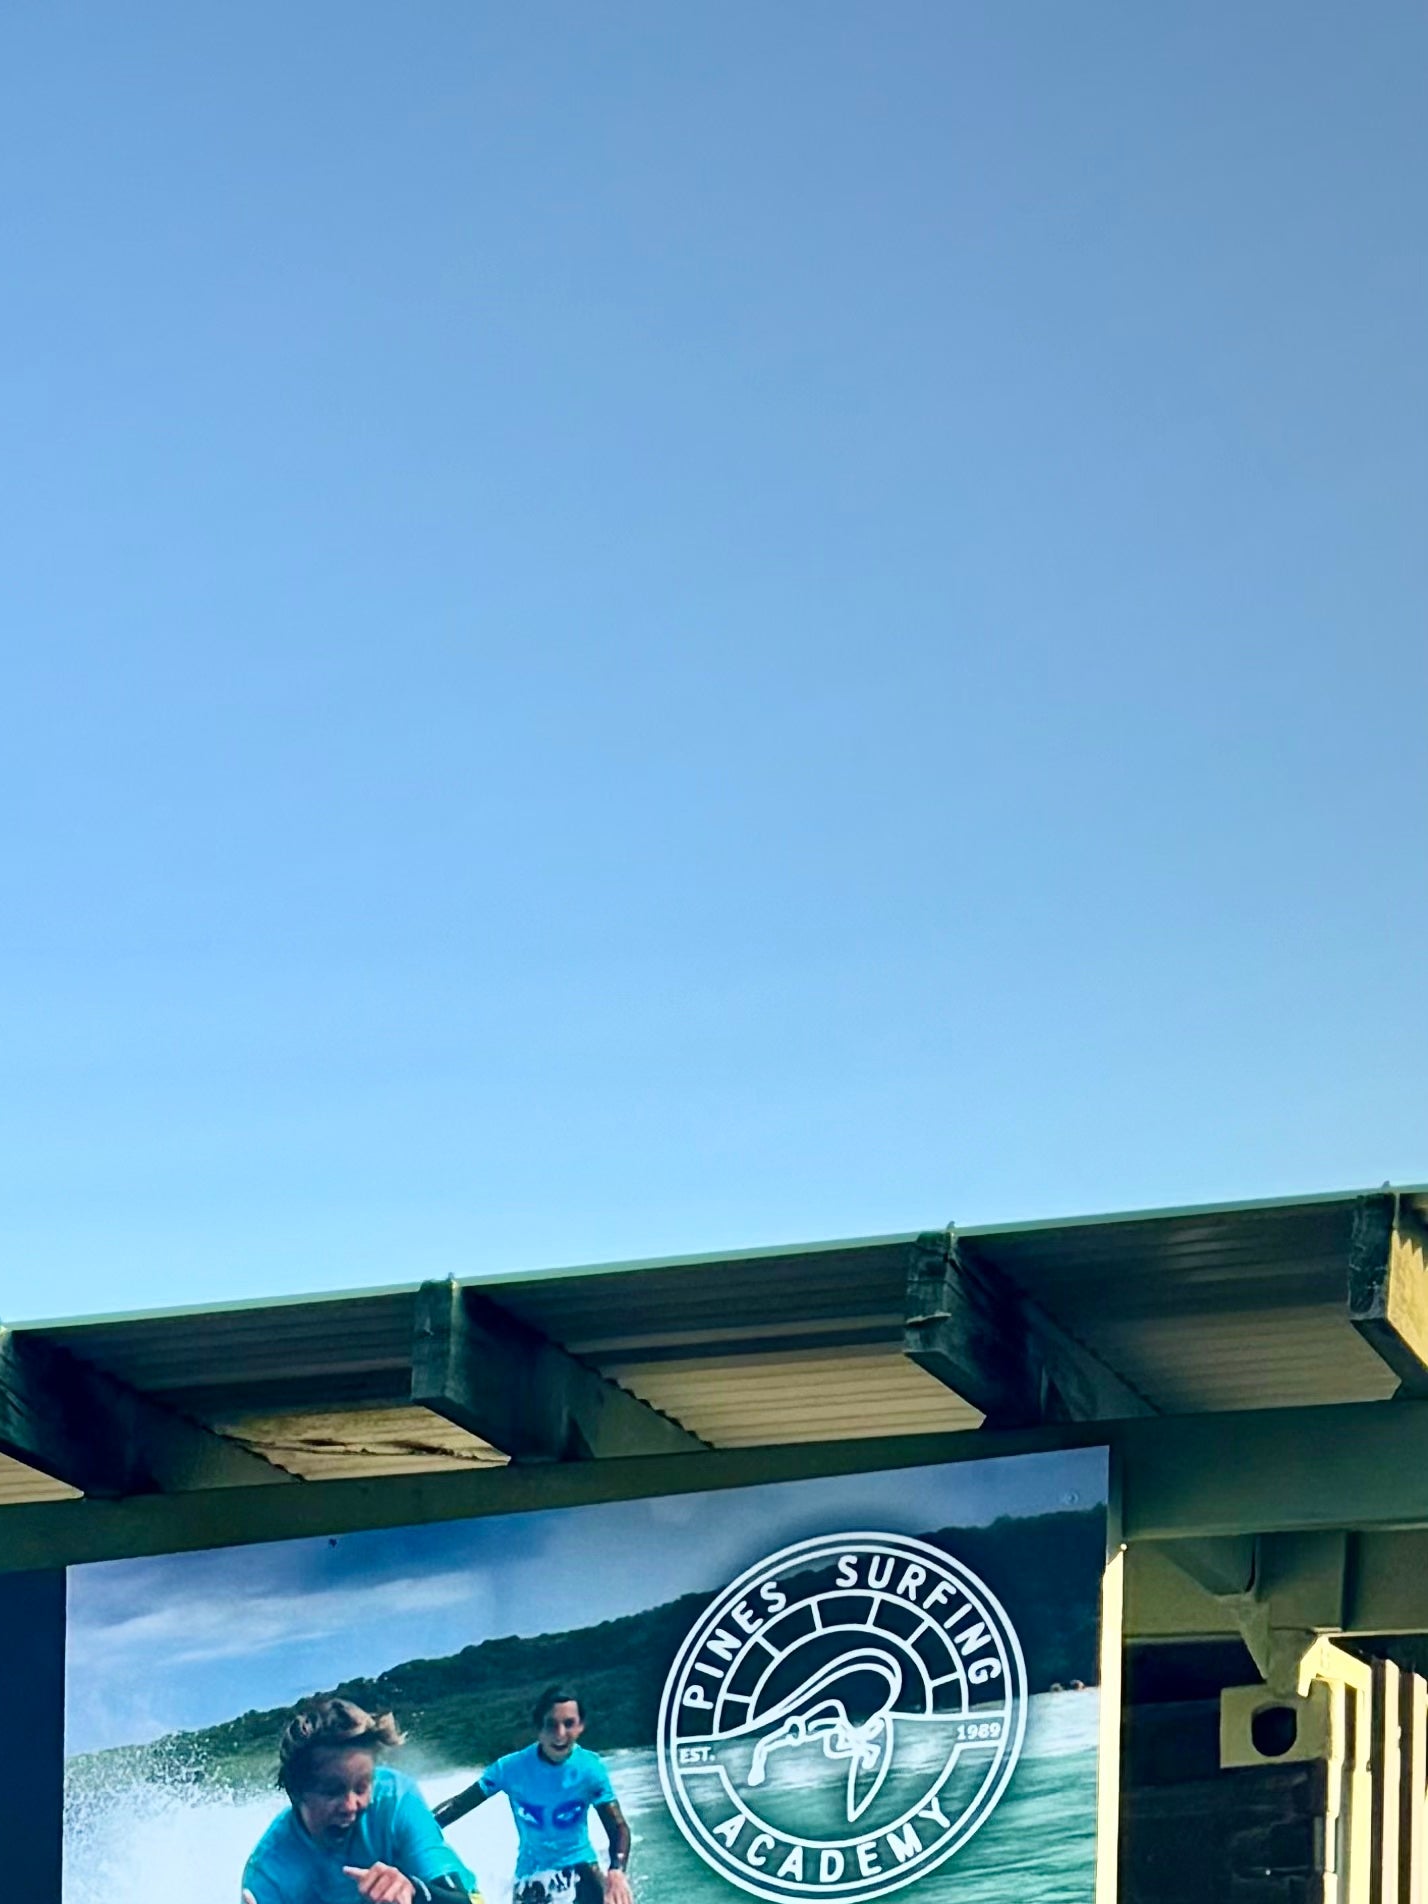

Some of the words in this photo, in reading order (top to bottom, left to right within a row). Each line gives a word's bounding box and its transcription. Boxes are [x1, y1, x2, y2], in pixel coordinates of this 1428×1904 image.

[682, 1580, 788, 1711] PINES
[835, 1554, 1002, 1686] SURFING
[678, 1746, 716, 1763] EST.
[956, 1721, 1002, 1740] 1989
[712, 1796, 951, 1883] ACADEMY
